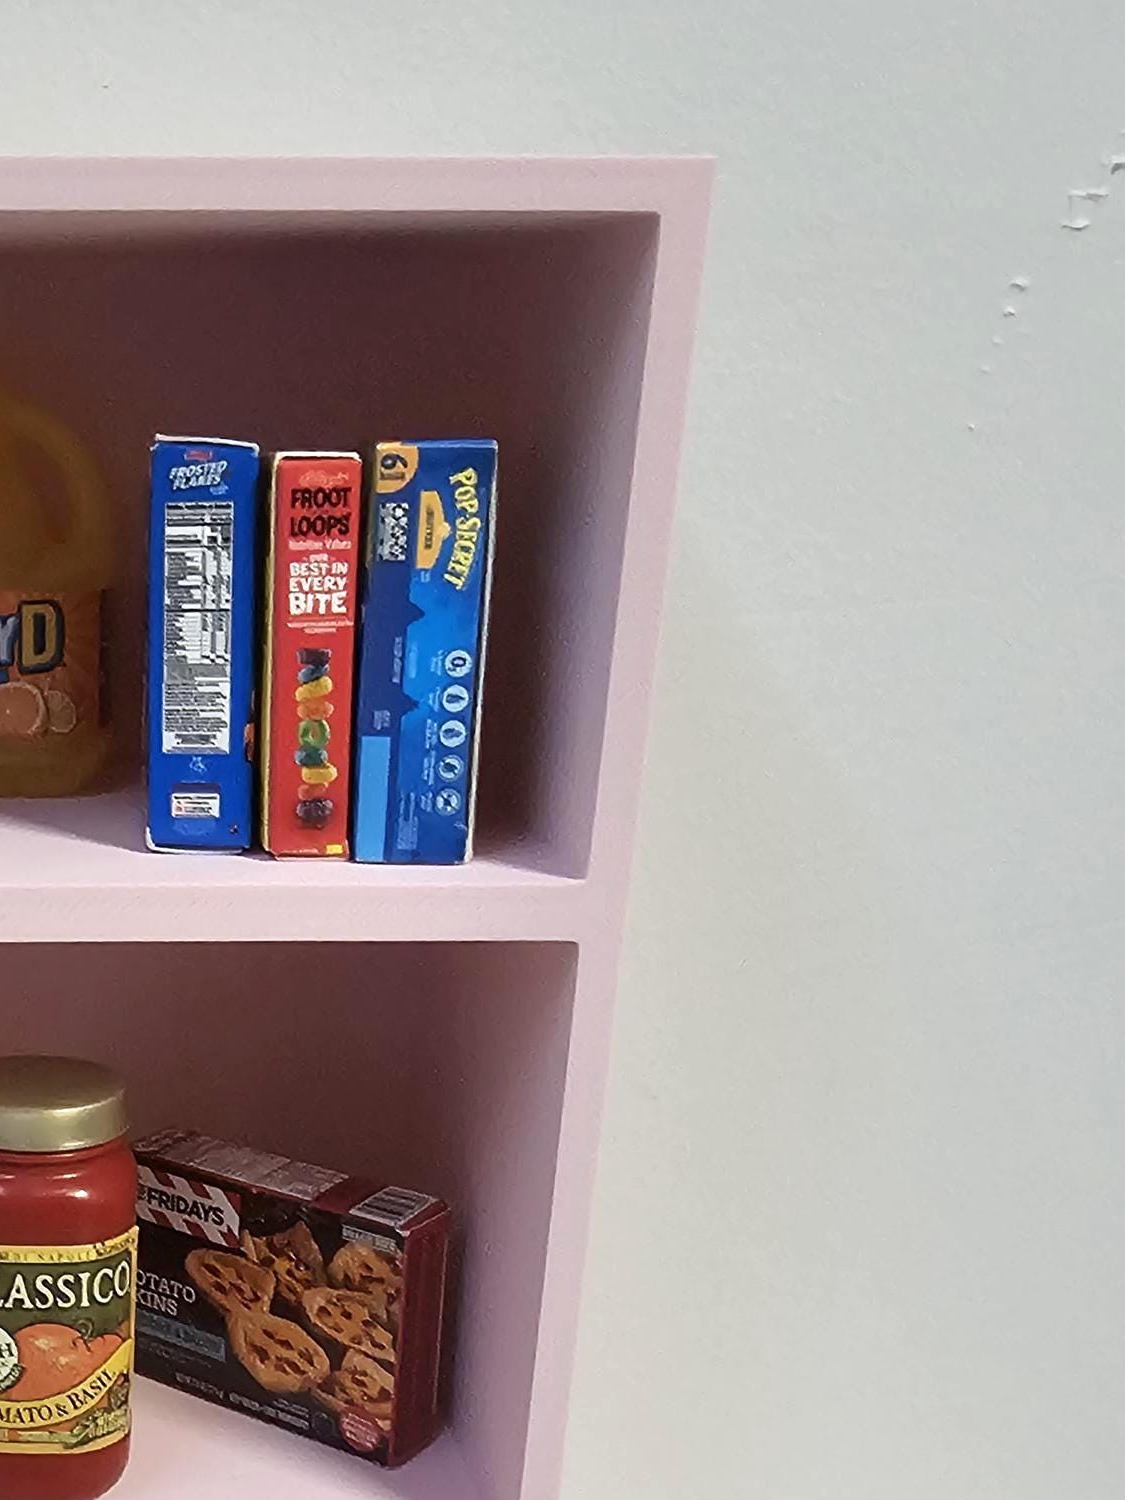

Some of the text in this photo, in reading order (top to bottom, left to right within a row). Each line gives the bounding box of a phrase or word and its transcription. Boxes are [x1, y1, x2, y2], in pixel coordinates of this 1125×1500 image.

[169, 460, 228, 479] FROSTED
[290, 487, 352, 509] FROOT
[290, 512, 352, 537] LOOPS
[289, 562, 348, 577] BEST IN
[288, 576, 348, 593] EVERY
[288, 591, 348, 616] BITE
[147, 1187, 225, 1226] FRIDAYS
[136, 1269, 196, 1303] OTATO
[136, 1289, 178, 1316] KINS
[56, 1404, 68, 1417] &
[66, 1369, 116, 1407] BASIL
